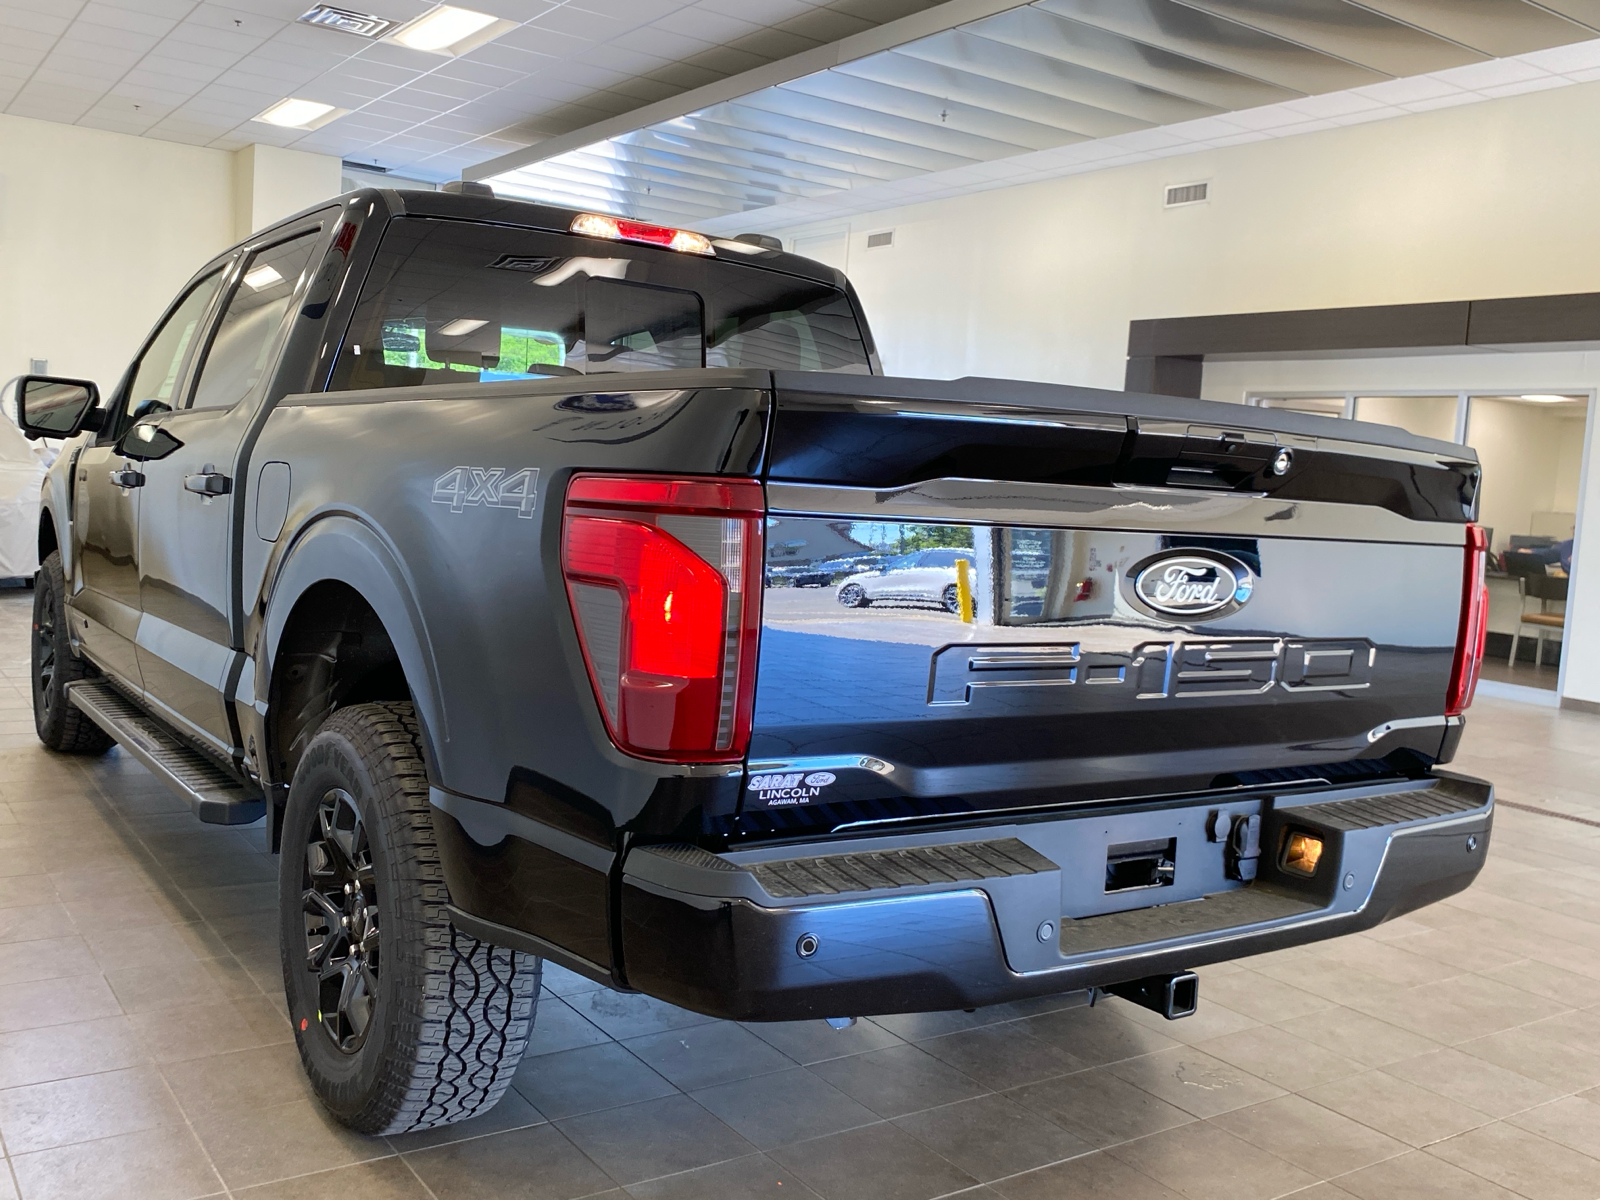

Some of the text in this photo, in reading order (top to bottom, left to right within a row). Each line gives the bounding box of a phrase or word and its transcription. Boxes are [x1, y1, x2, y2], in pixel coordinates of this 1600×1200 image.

[1155, 565, 1222, 606] Ford
[926, 636, 1377, 706] F-150
[747, 773, 804, 791] SARAT
[759, 787, 820, 799] LINCOLN
